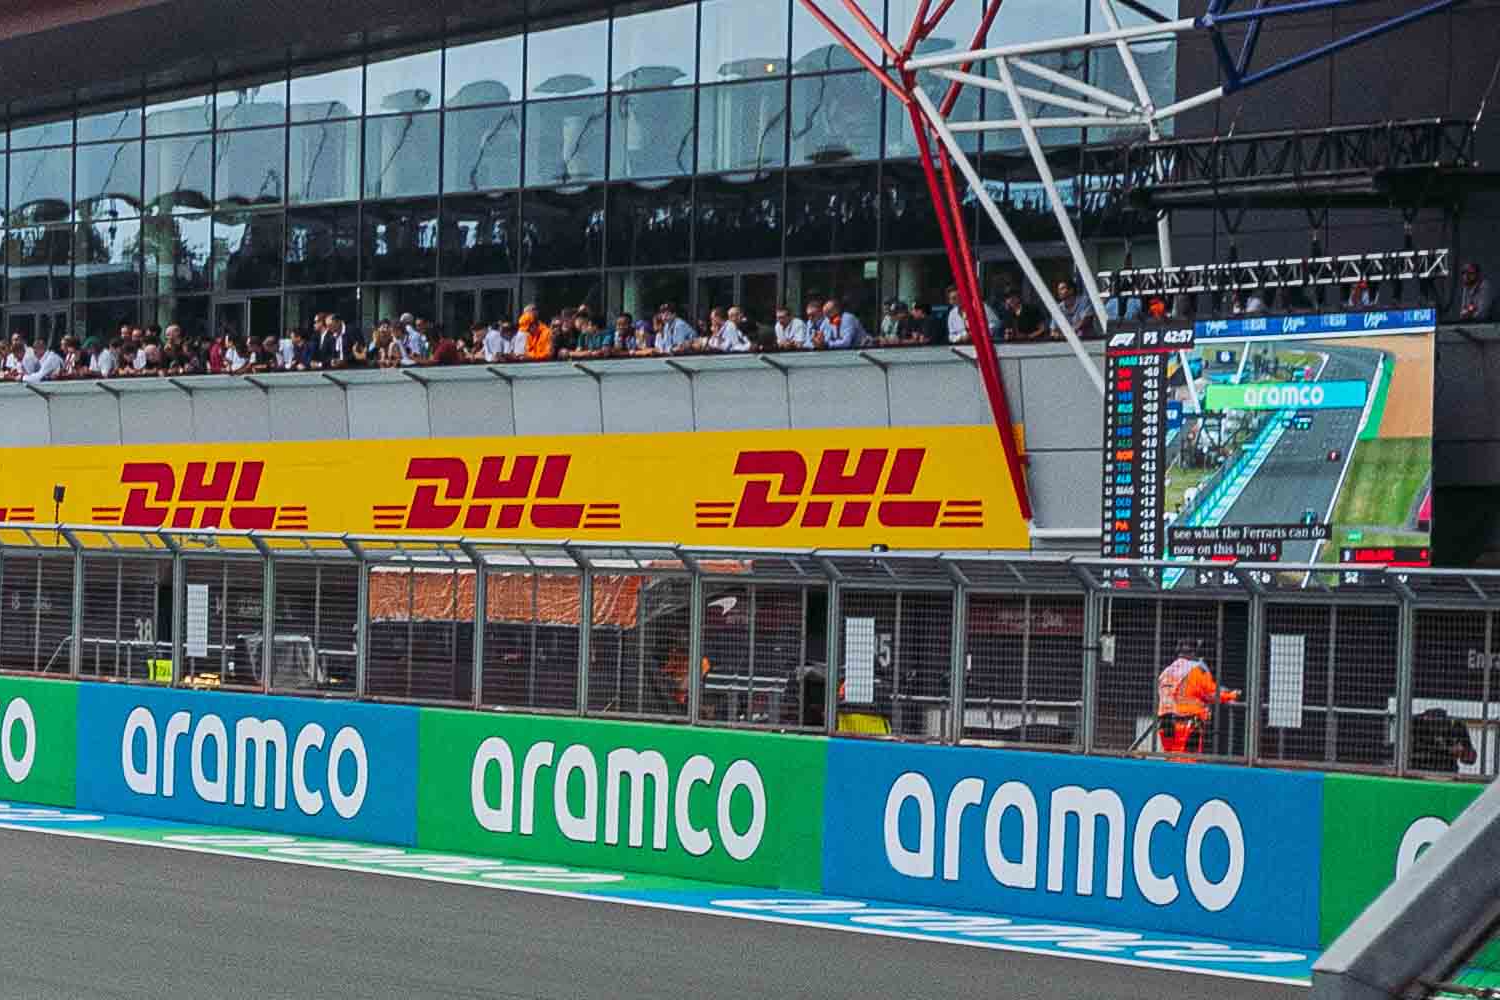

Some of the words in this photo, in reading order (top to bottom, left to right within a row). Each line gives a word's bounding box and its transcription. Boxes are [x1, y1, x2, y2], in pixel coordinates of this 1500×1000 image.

[1244, 384, 1324, 405] aramco
[122, 462, 277, 529] DHL
[405, 455, 584, 529] DHL
[733, 448, 941, 528] DHL
[1173, 529, 1192, 539] see
[1194, 527, 1220, 539] what
[1222, 526, 1241, 538] the
[1311, 525, 1327, 538] do
[1173, 545, 1196, 554] now
[1197, 545, 1211, 554] on
[1213, 541, 1234, 554] this
[123, 707, 367, 818] aramco
[471, 737, 766, 860] aramco
[885, 773, 1244, 911] aramco
[710, 898, 1309, 963] aramco
